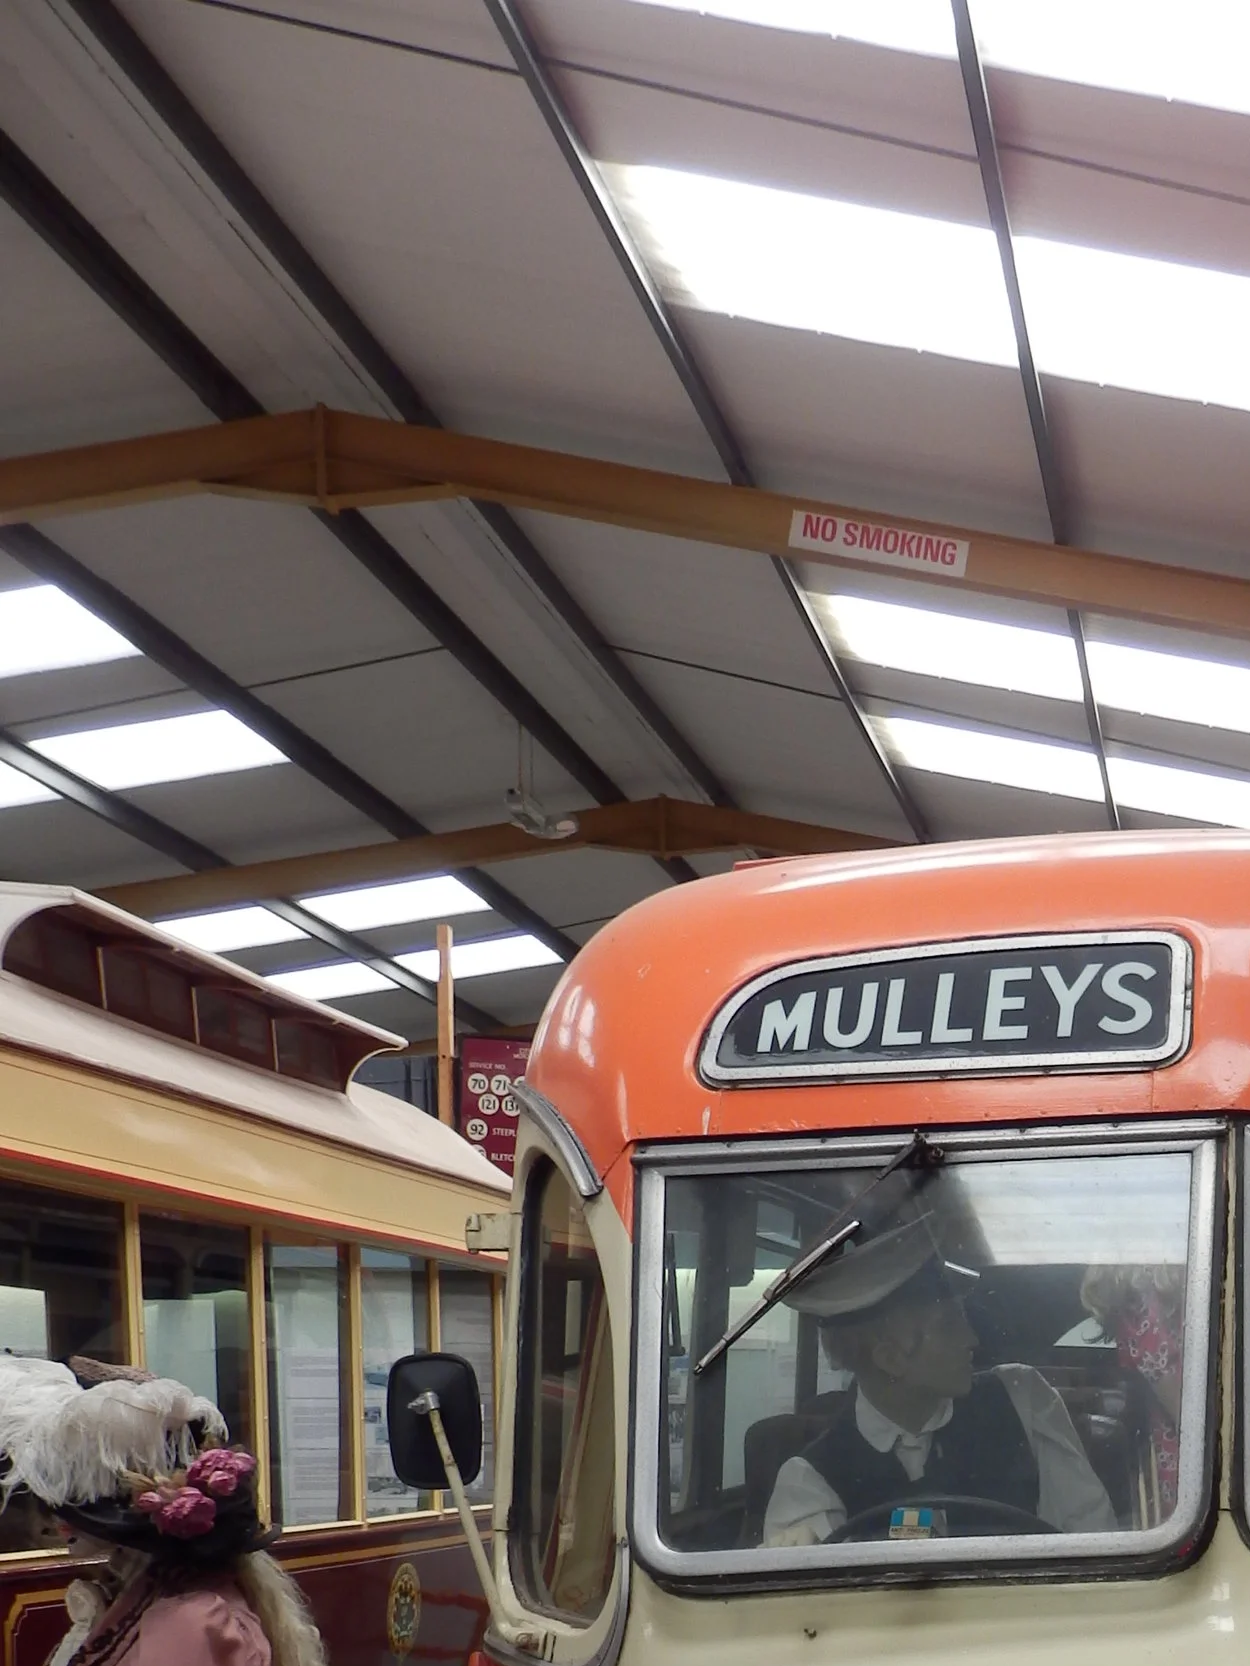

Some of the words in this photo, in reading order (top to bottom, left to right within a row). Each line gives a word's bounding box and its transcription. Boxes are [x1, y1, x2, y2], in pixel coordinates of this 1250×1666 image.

[802, 513, 838, 543] NO
[842, 522, 958, 566] SMOKING
[756, 961, 1157, 1054] MULLEYS
[471, 1078, 486, 1090] 70
[495, 1079, 506, 1091] 71
[481, 1098, 496, 1110] 121
[470, 1123, 485, 1135] 92
